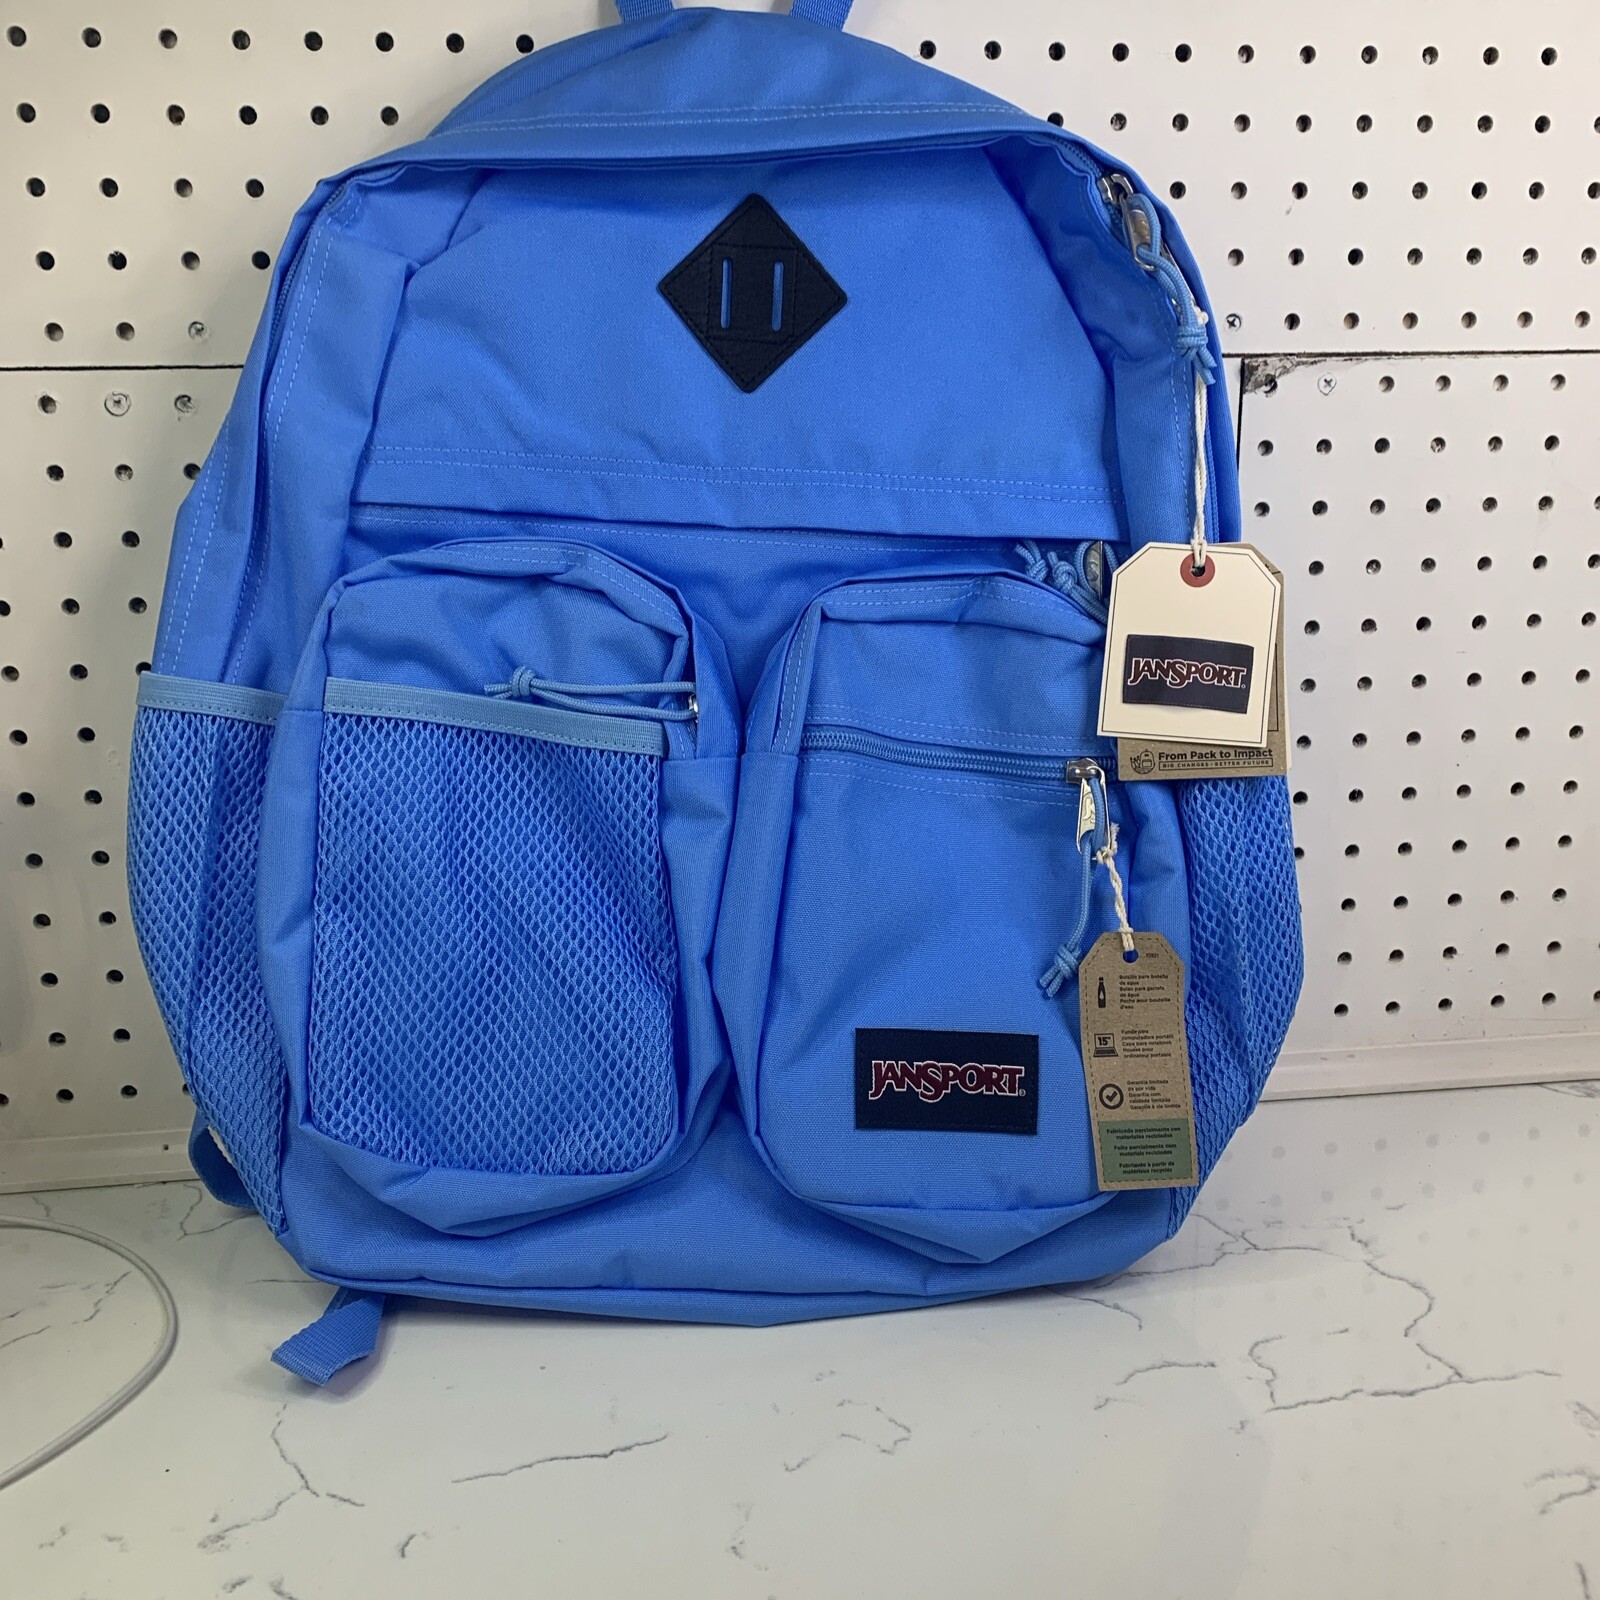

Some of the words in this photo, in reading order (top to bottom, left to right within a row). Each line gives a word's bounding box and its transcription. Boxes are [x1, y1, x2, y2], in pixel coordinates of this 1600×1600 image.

[1128, 657, 1247, 689] JANSPORT
[1158, 752, 1187, 761] From
[1190, 751, 1217, 760] Pack
[1220, 751, 1231, 759] to
[1234, 749, 1273, 760] Impact
[869, 1060, 1025, 1103] JANSPORT
